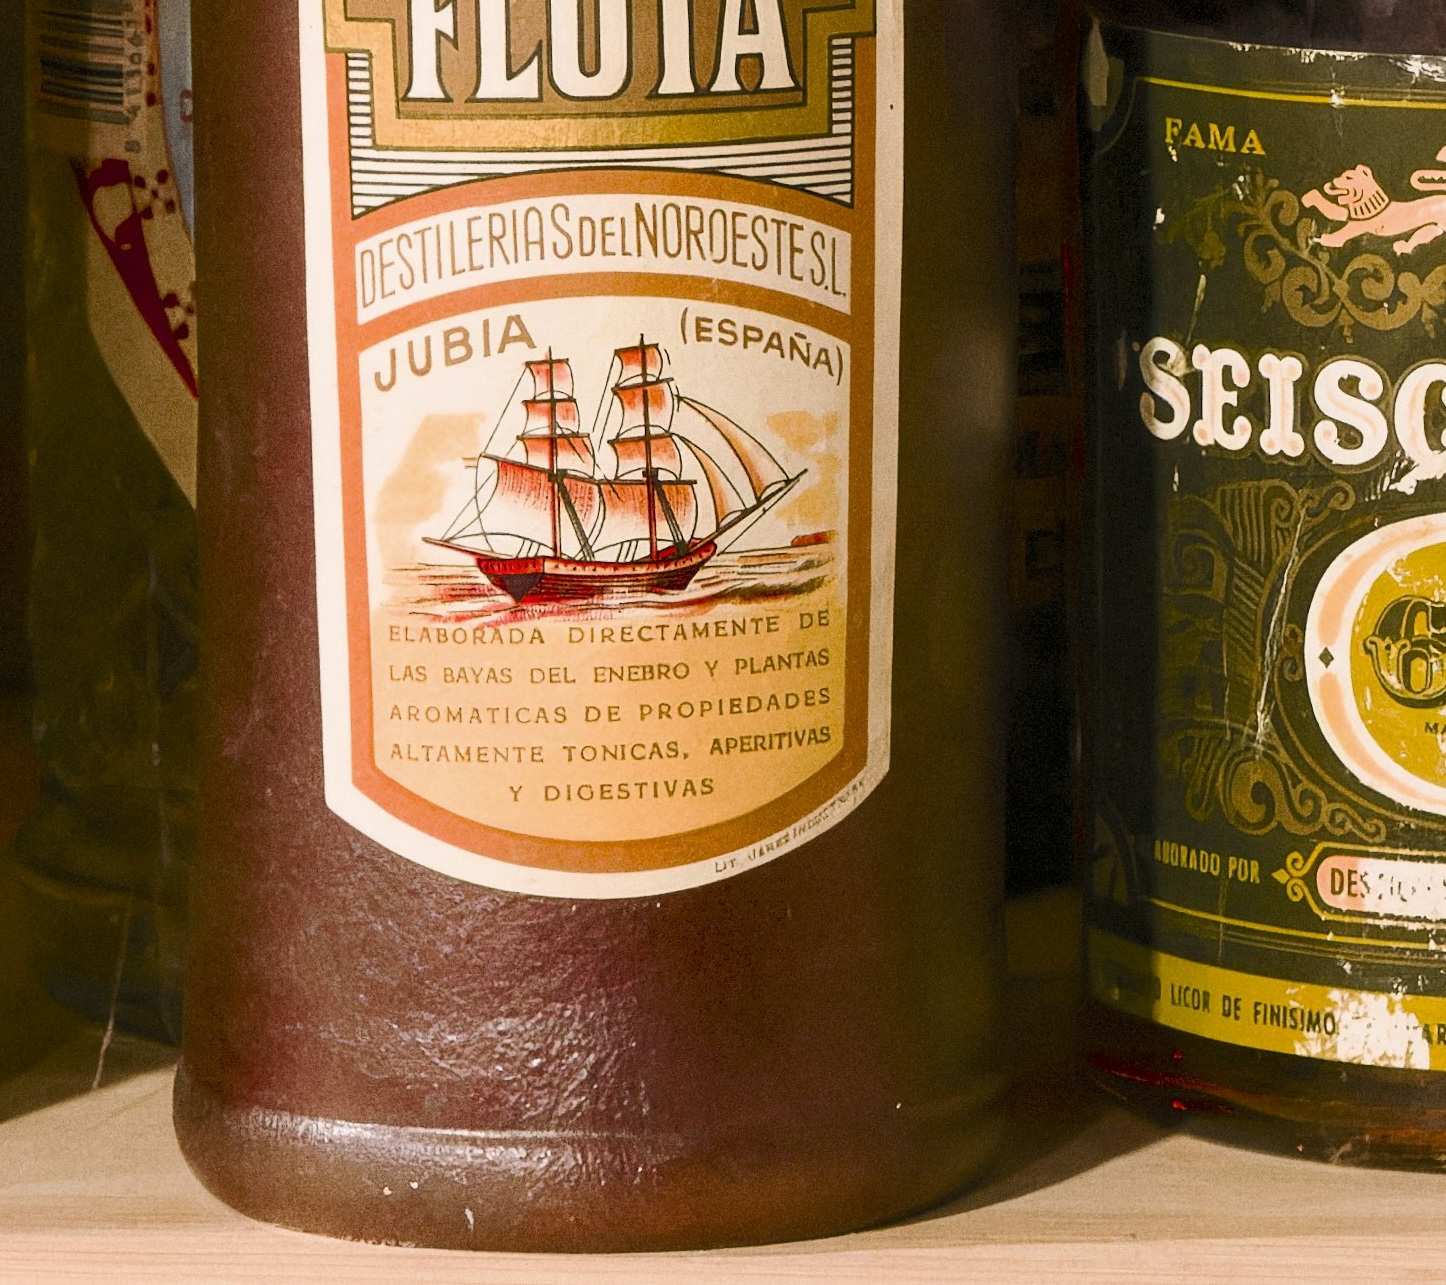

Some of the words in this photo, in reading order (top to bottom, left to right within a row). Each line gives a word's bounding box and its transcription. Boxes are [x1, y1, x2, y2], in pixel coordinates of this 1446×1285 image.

[1162, 115, 1269, 159] FAMA
[359, 201, 574, 310] DESTILERIAS
[578, 214, 634, 258] DEL
[632, 200, 805, 281] NOROESTE
[373, 313, 538, 394] JUBIA
[678, 305, 845, 388] (ESPAÑA)
[387, 622, 546, 646] ELABORADA
[567, 615, 781, 645] DIRECTAMENTE
[798, 608, 832, 631] DE
[388, 663, 428, 686] LAS
[441, 664, 514, 687] BAYAS
[528, 665, 577, 686] DEL
[592, 660, 691, 686] ENEBRO
[704, 658, 720, 679] Y
[733, 647, 832, 676] PLANTAS
[388, 702, 568, 725] AROMATICAS
[583, 703, 623, 724] DE
[638, 686, 832, 722] PROPIEDADES
[388, 741, 545, 765] ALTAMENTE
[561, 739, 691, 765] TONICAS,
[708, 724, 833, 758] APERITIVAS
[508, 783, 525, 804] Y
[542, 775, 716, 804] DIGESTIVAS
[1227, 855, 1261, 885] POR
[1169, 981, 1212, 1014] LICOR
[1221, 994, 1242, 1021] DE
[1252, 1000, 1337, 1037] FINISIMO
